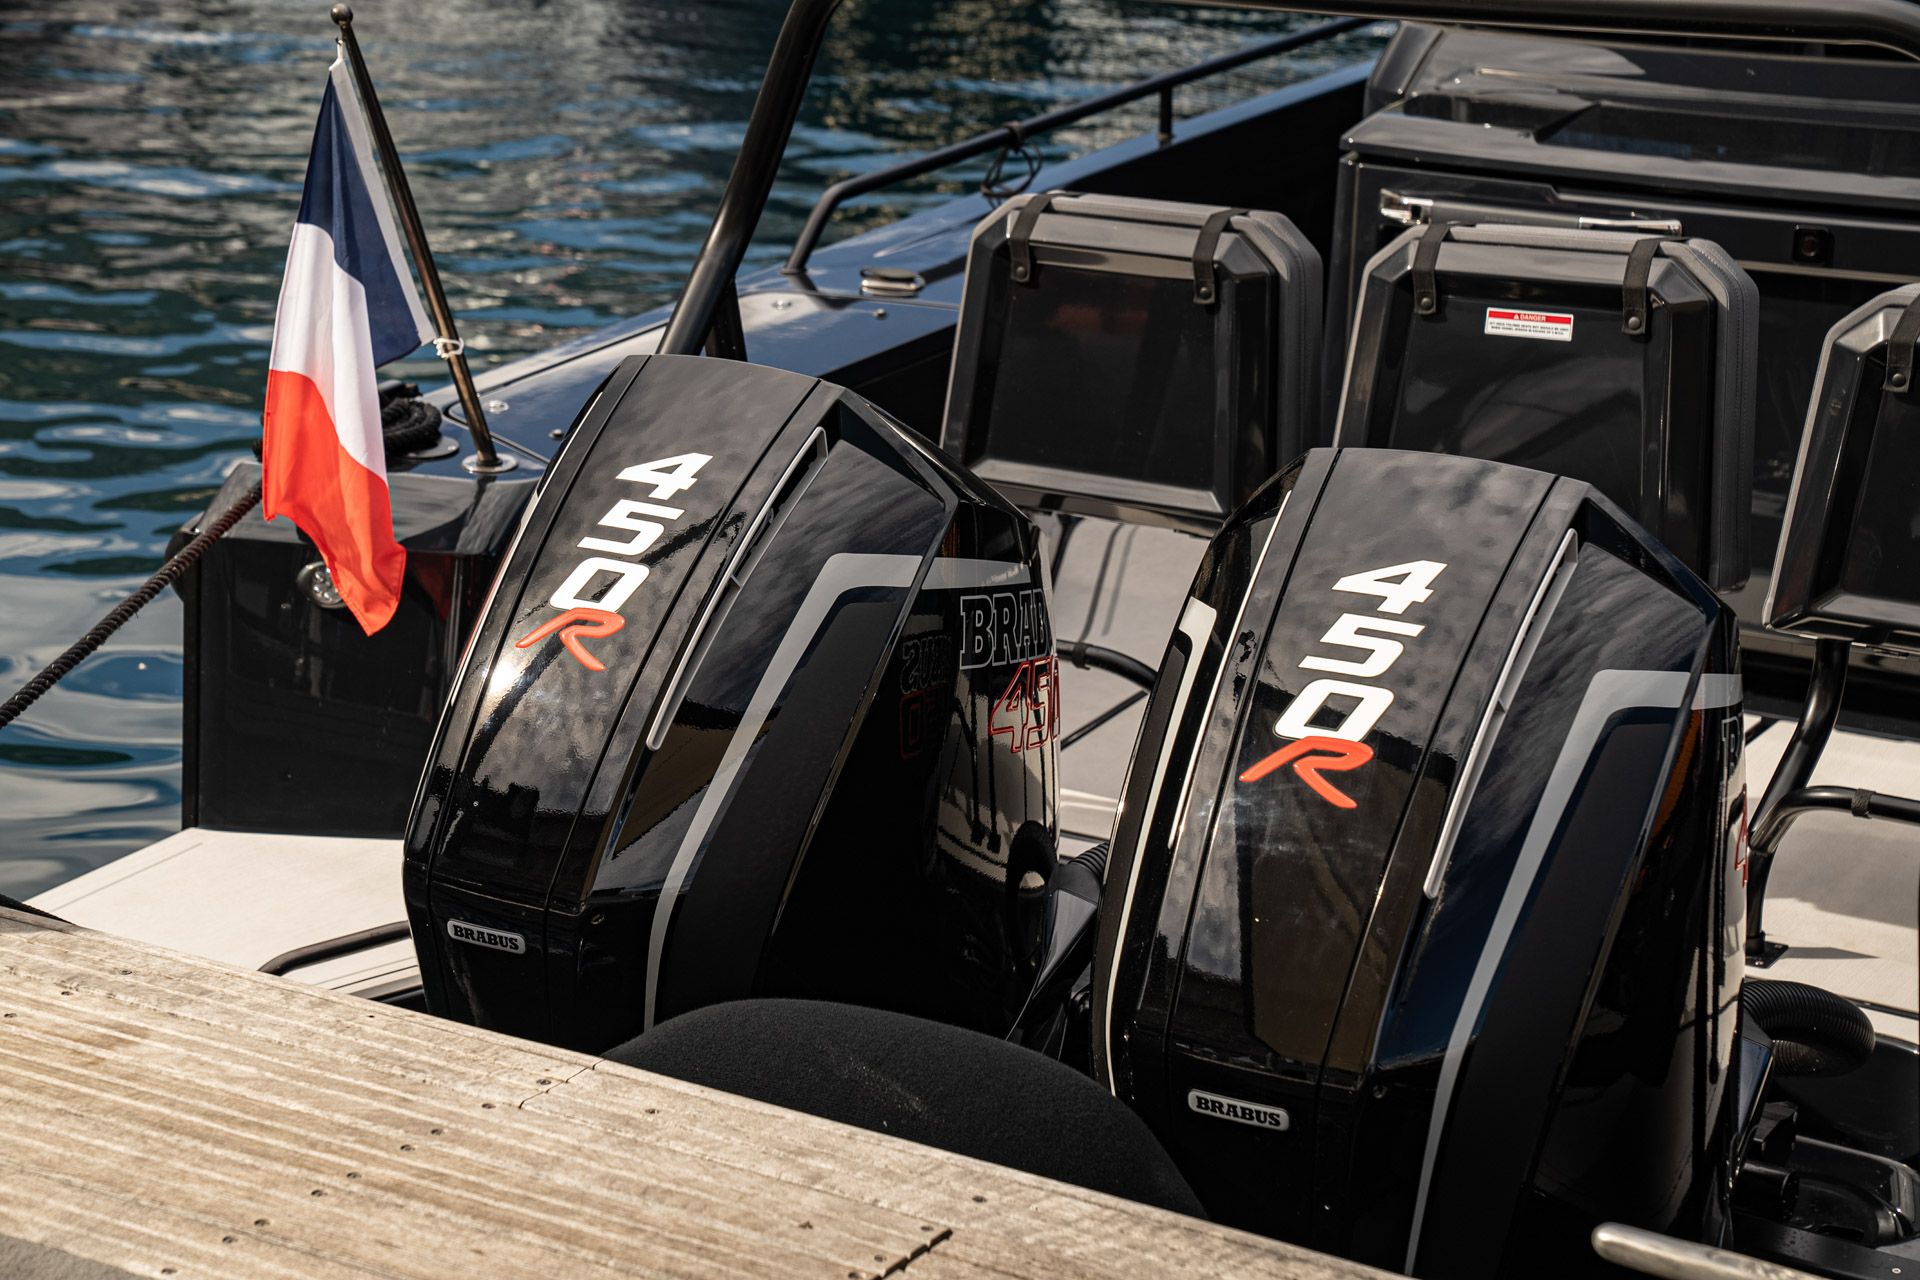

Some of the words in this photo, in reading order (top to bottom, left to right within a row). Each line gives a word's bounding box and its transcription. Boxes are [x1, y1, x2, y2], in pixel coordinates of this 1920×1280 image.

[1520, 314, 1546, 322] DANGER
[453, 924, 519, 951] BRABUS
[1196, 1095, 1281, 1127] BRABUS
